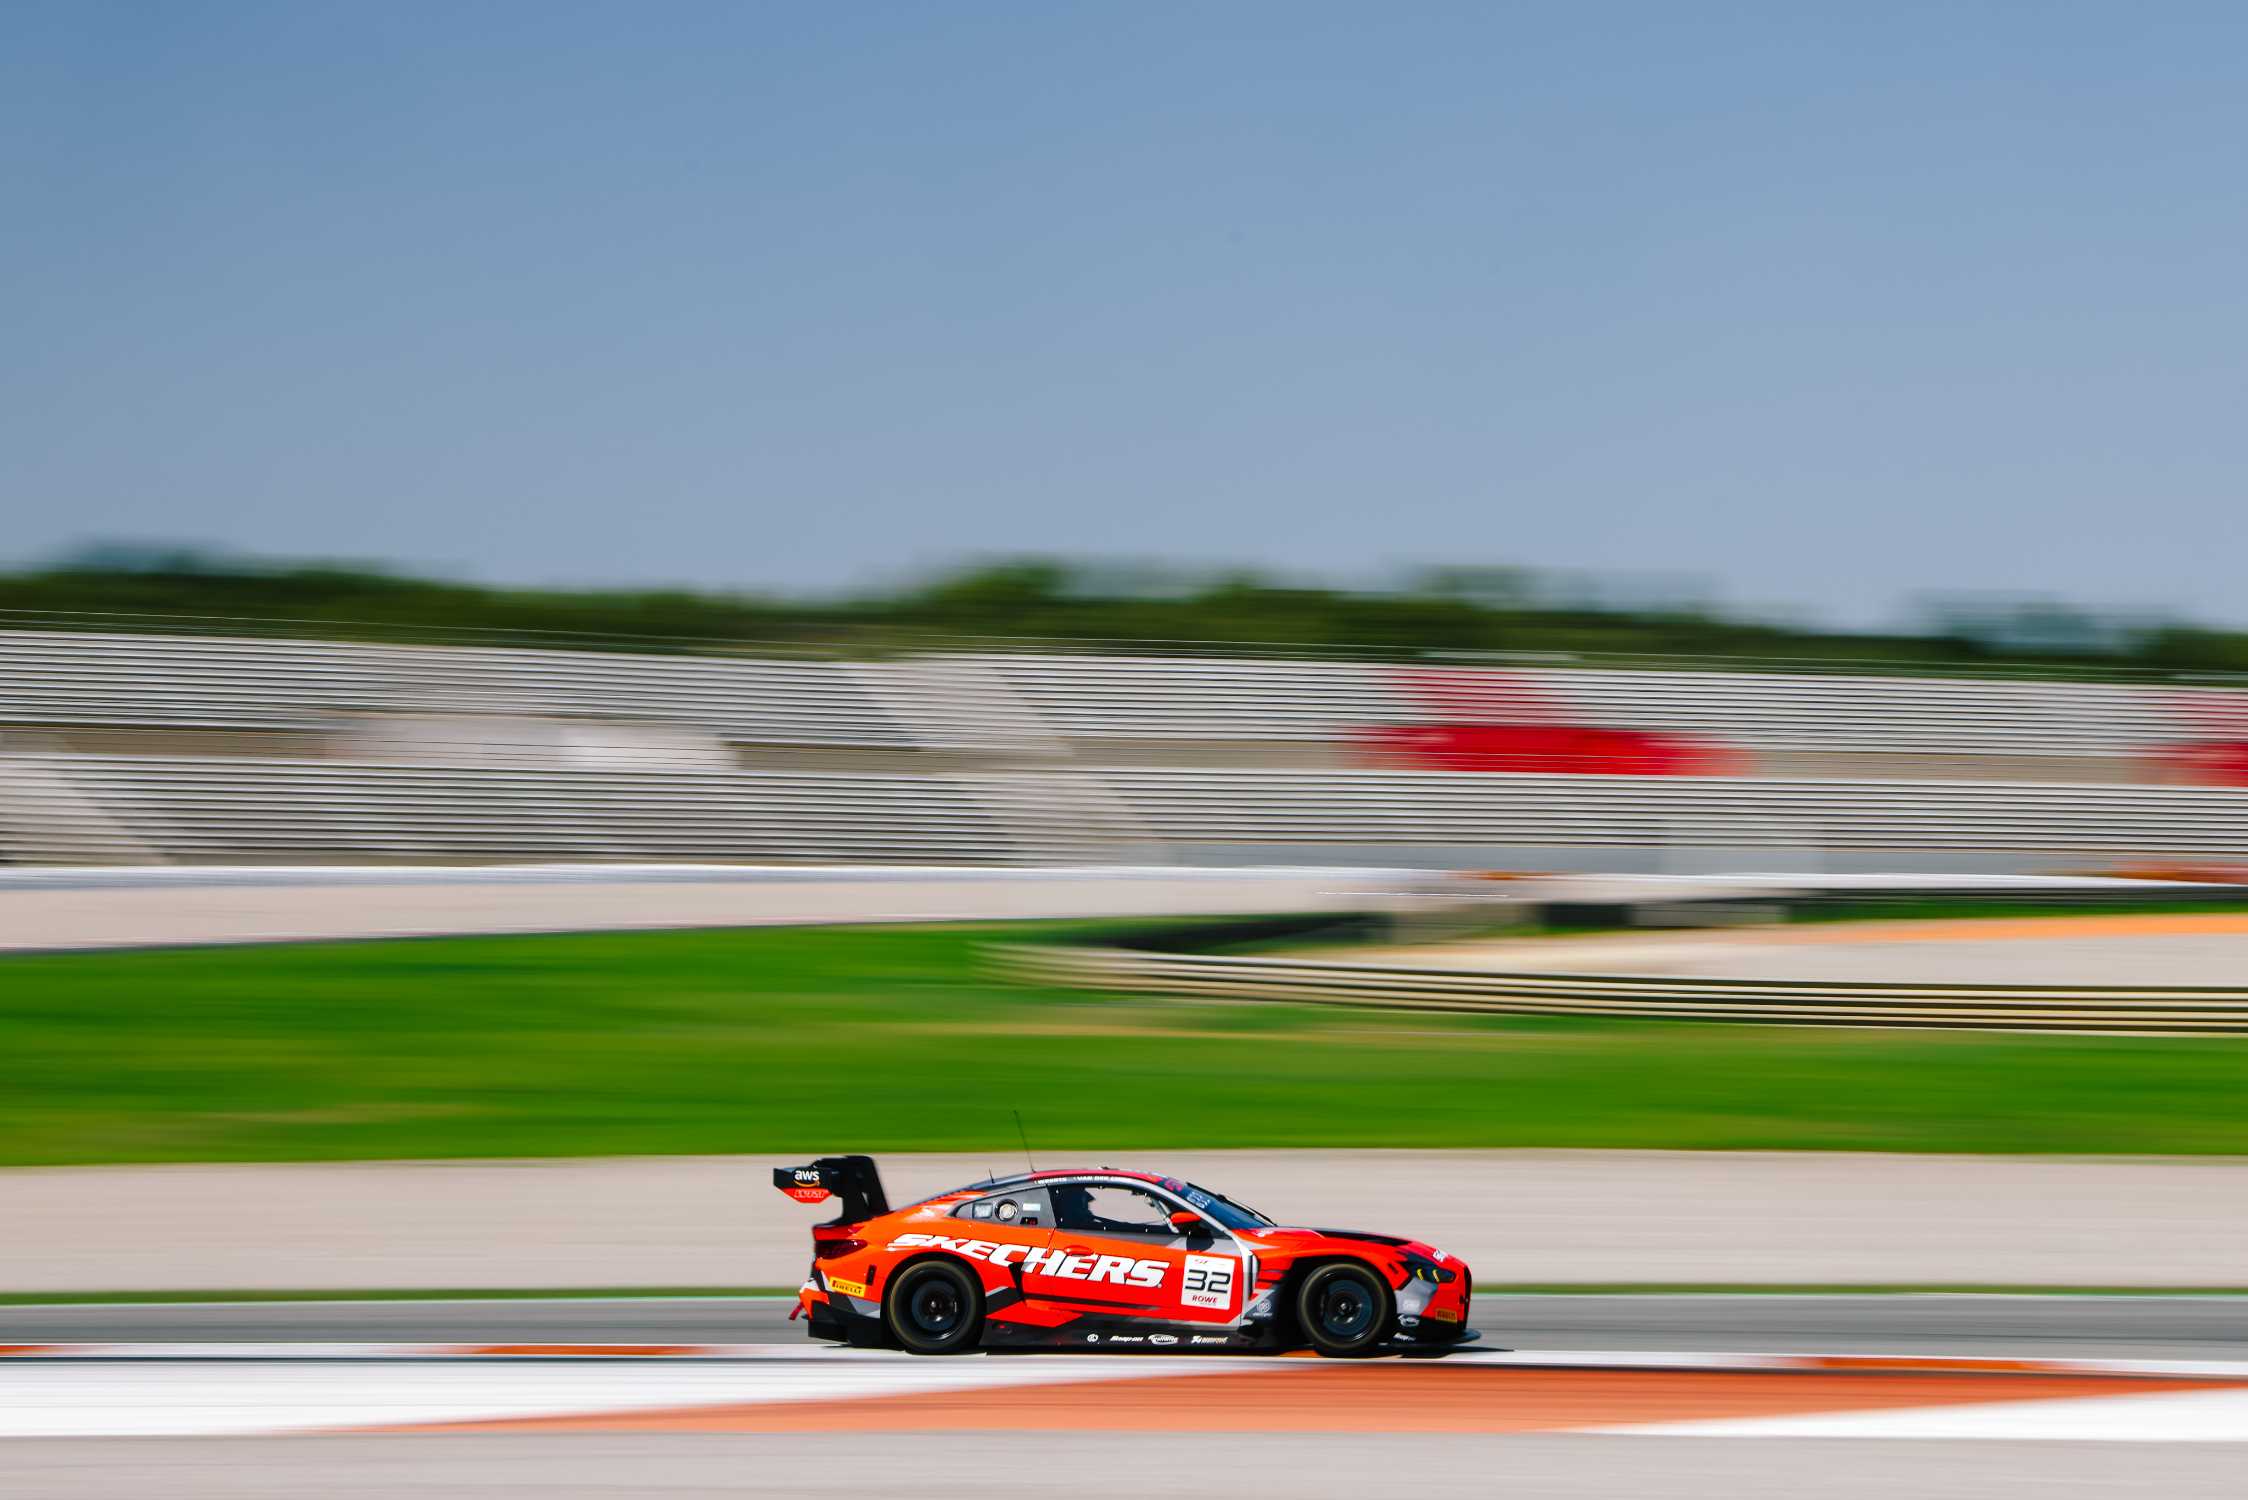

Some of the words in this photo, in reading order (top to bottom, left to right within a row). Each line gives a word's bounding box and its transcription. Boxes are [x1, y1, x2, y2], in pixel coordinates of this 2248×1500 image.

[794, 1170, 820, 1181] aws
[886, 1233, 1170, 1287] SKECHERS
[1185, 1269, 1231, 1294] 32
[1192, 1294, 1217, 1304] ROWE
